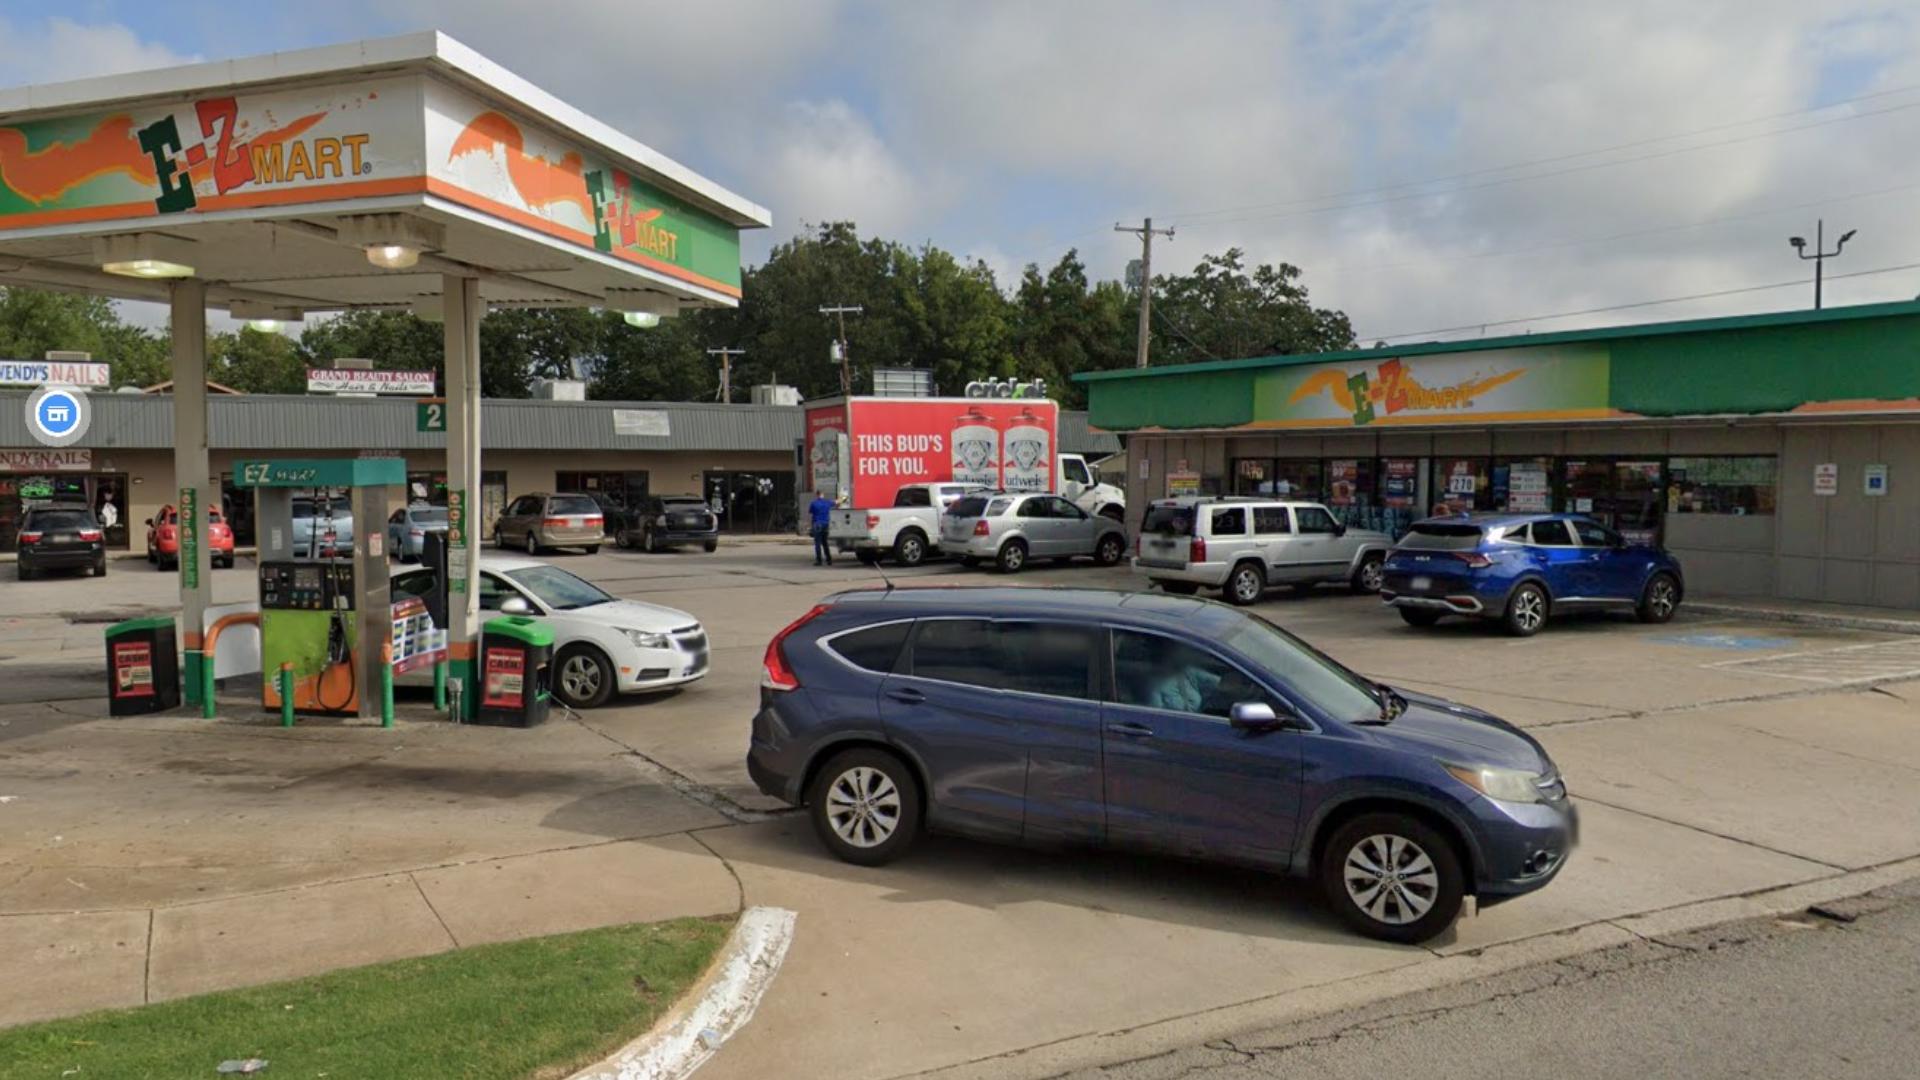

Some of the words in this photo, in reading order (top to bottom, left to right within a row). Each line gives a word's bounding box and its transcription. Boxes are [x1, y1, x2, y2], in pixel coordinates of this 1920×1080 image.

[138, 97, 256, 214] E-Z
[253, 134, 370, 185] MART
[585, 169, 636, 254] E-Z
[635, 220, 679, 261] MART
[51, 364, 107, 385] NAILS
[311, 369, 351, 380] GRAND
[353, 370, 393, 382] BEAUTY
[395, 371, 430, 383] SALON
[1347, 357, 1409, 425] E-Z
[1407, 386, 1470, 410] MART
[427, 404, 441, 428] 2
[857, 434, 893, 453] THIS
[897, 433, 944, 453] BUD'S
[40, 451, 90, 465] NAILS
[859, 457, 889, 476] FOR
[893, 456, 928, 476] YOU.
